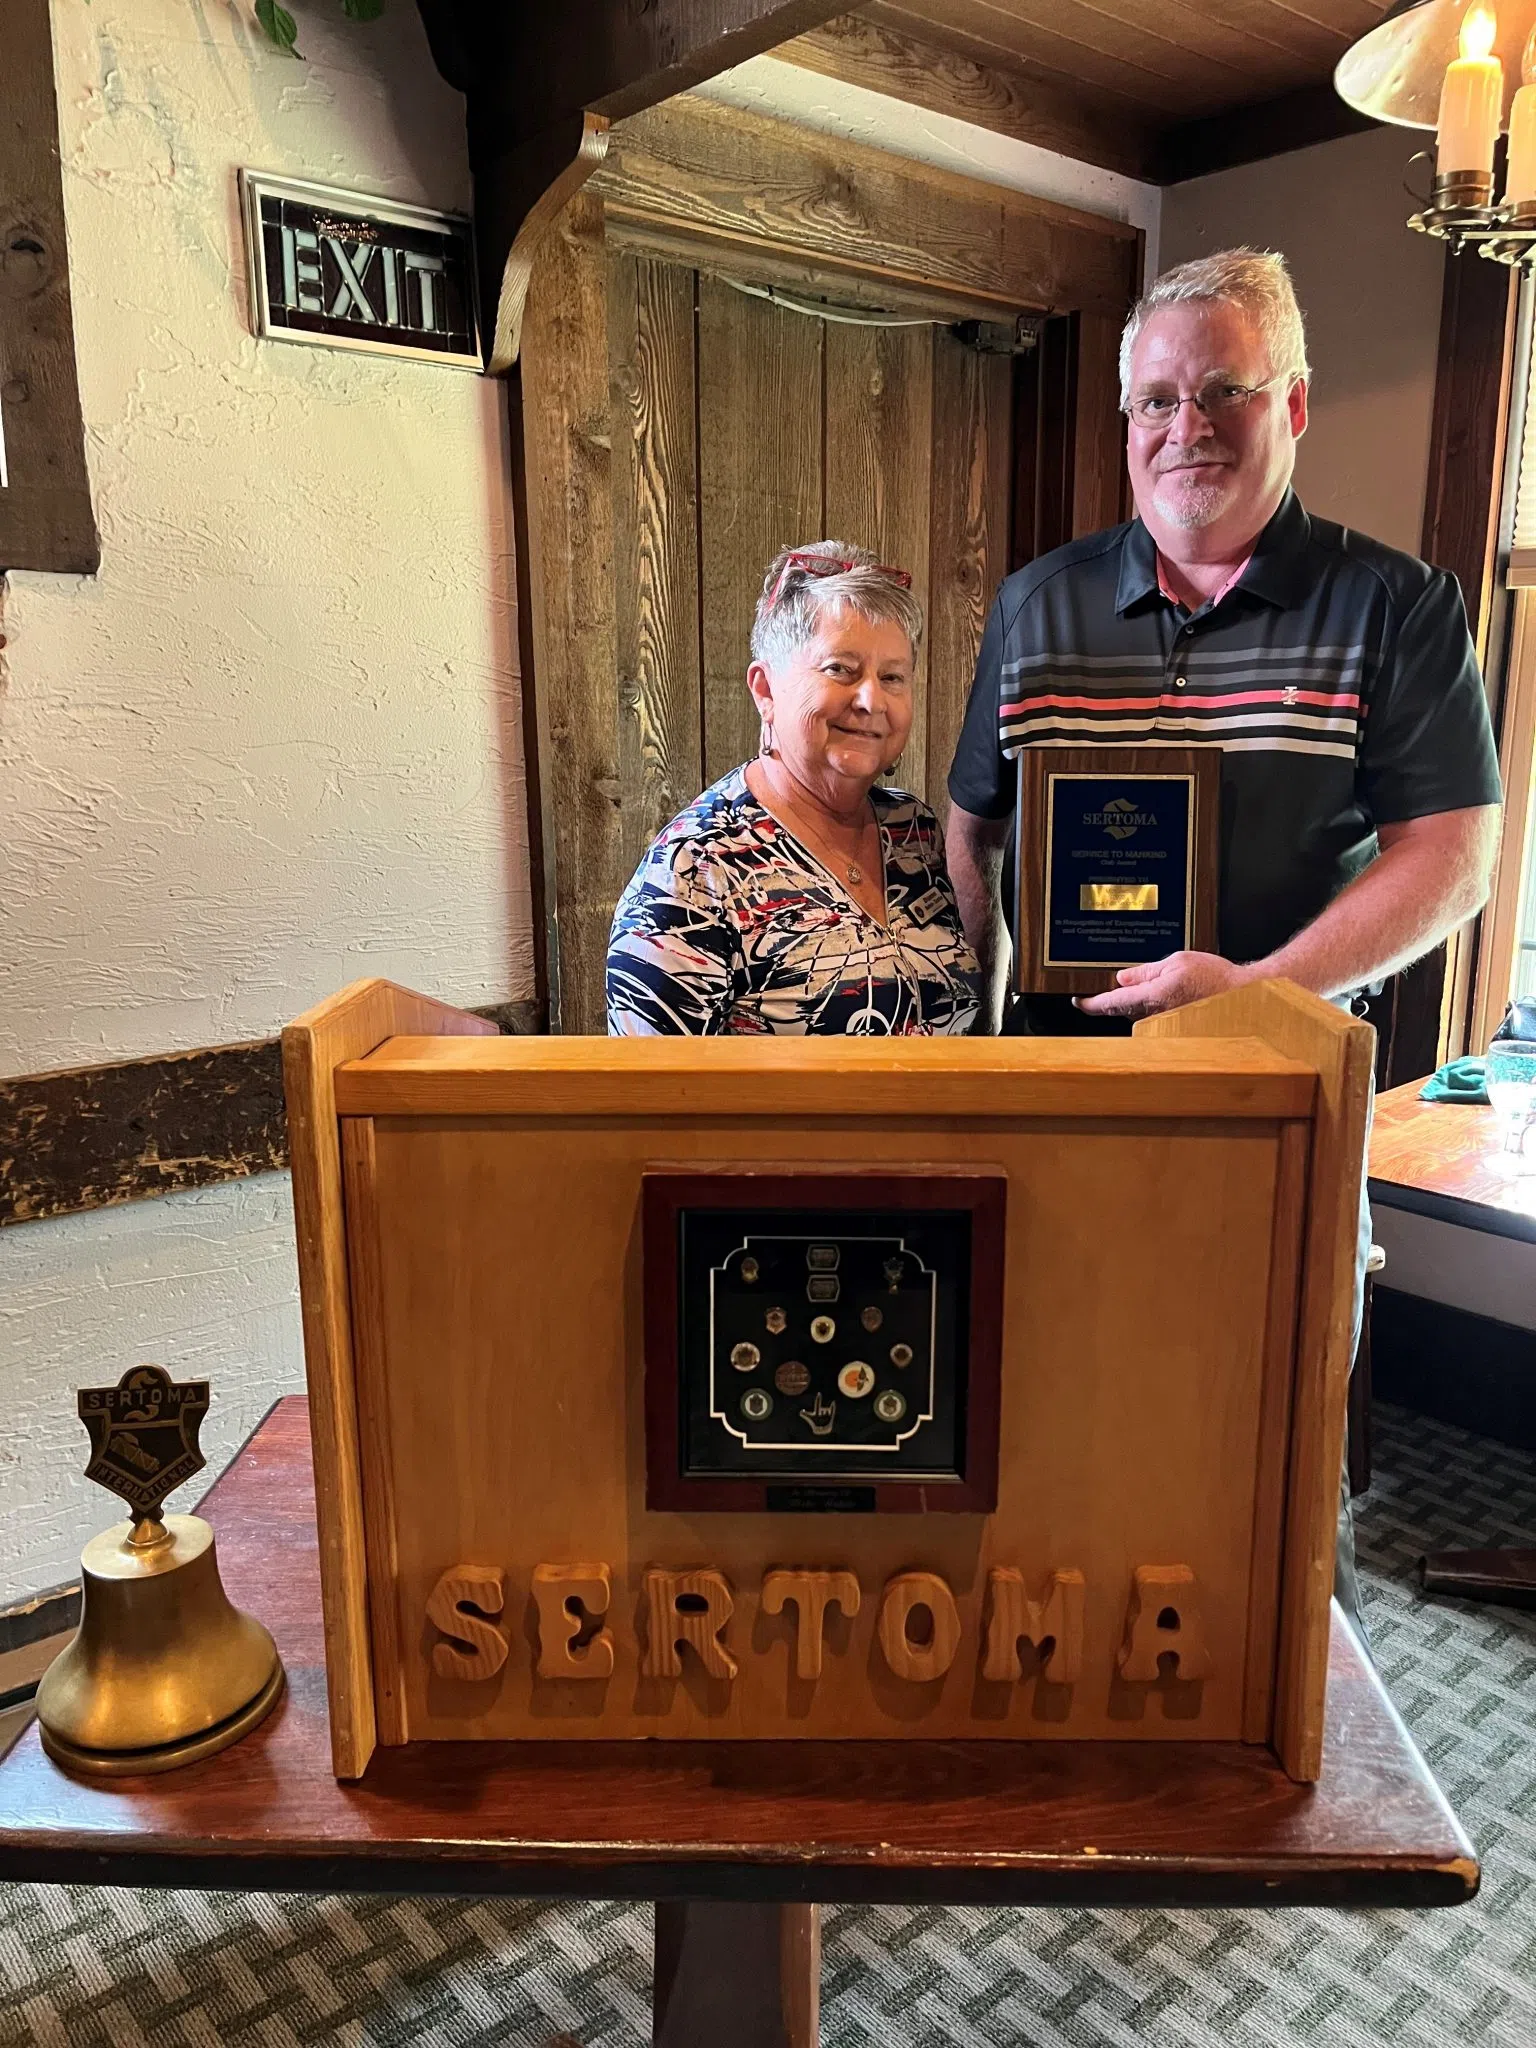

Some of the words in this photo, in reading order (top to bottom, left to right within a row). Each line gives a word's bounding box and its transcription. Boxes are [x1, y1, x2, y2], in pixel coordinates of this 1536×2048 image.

[281, 227, 444, 330] EXIT
[1082, 812, 1158, 825] SERTOMA
[1111, 850, 1123, 858] TO
[89, 1388, 197, 1408] SERTOMA
[93, 1459, 196, 1501] INTERNATIONAL
[425, 1563, 1202, 1682] SERTOMA
